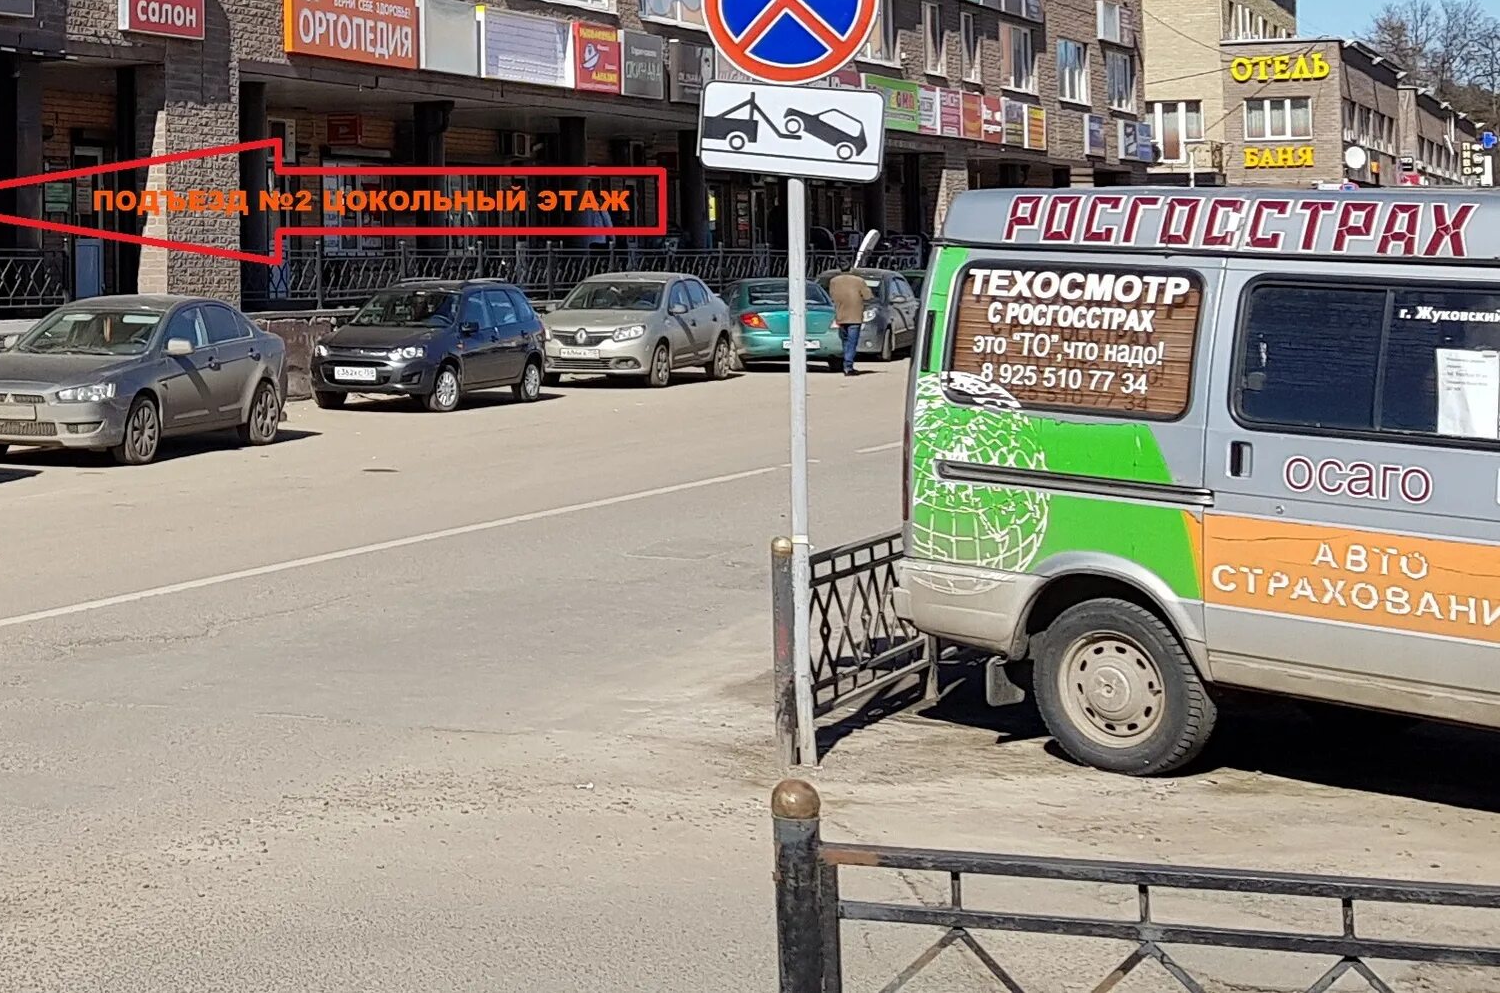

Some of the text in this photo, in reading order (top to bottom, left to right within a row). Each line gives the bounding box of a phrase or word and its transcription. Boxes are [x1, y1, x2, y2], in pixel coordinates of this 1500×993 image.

[358, 0, 374, 13] СЕБЕ
[299, 8, 412, 60] ОРТОПЕДИЯ
[1230, 53, 1331, 82] ОТЕЛЬ
[1244, 145, 1314, 169] БАНЯ
[1462, 142, 1472, 175] ПИВО
[1002, 193, 1481, 258] РОСГОССТРАХ
[968, 268, 1191, 305] ТЕХОСМОТР
[987, 302, 1156, 333] С РОСГОССТРАХ
[1399, 308, 1412, 319] г.
[972, 335, 1007, 354] это
[1104, 341, 1165, 369] надо!
[980, 362, 1149, 394] 8 925 510 77 34
[1284, 455, 1434, 504] осаго
[1311, 542, 1430, 580] АВТО
